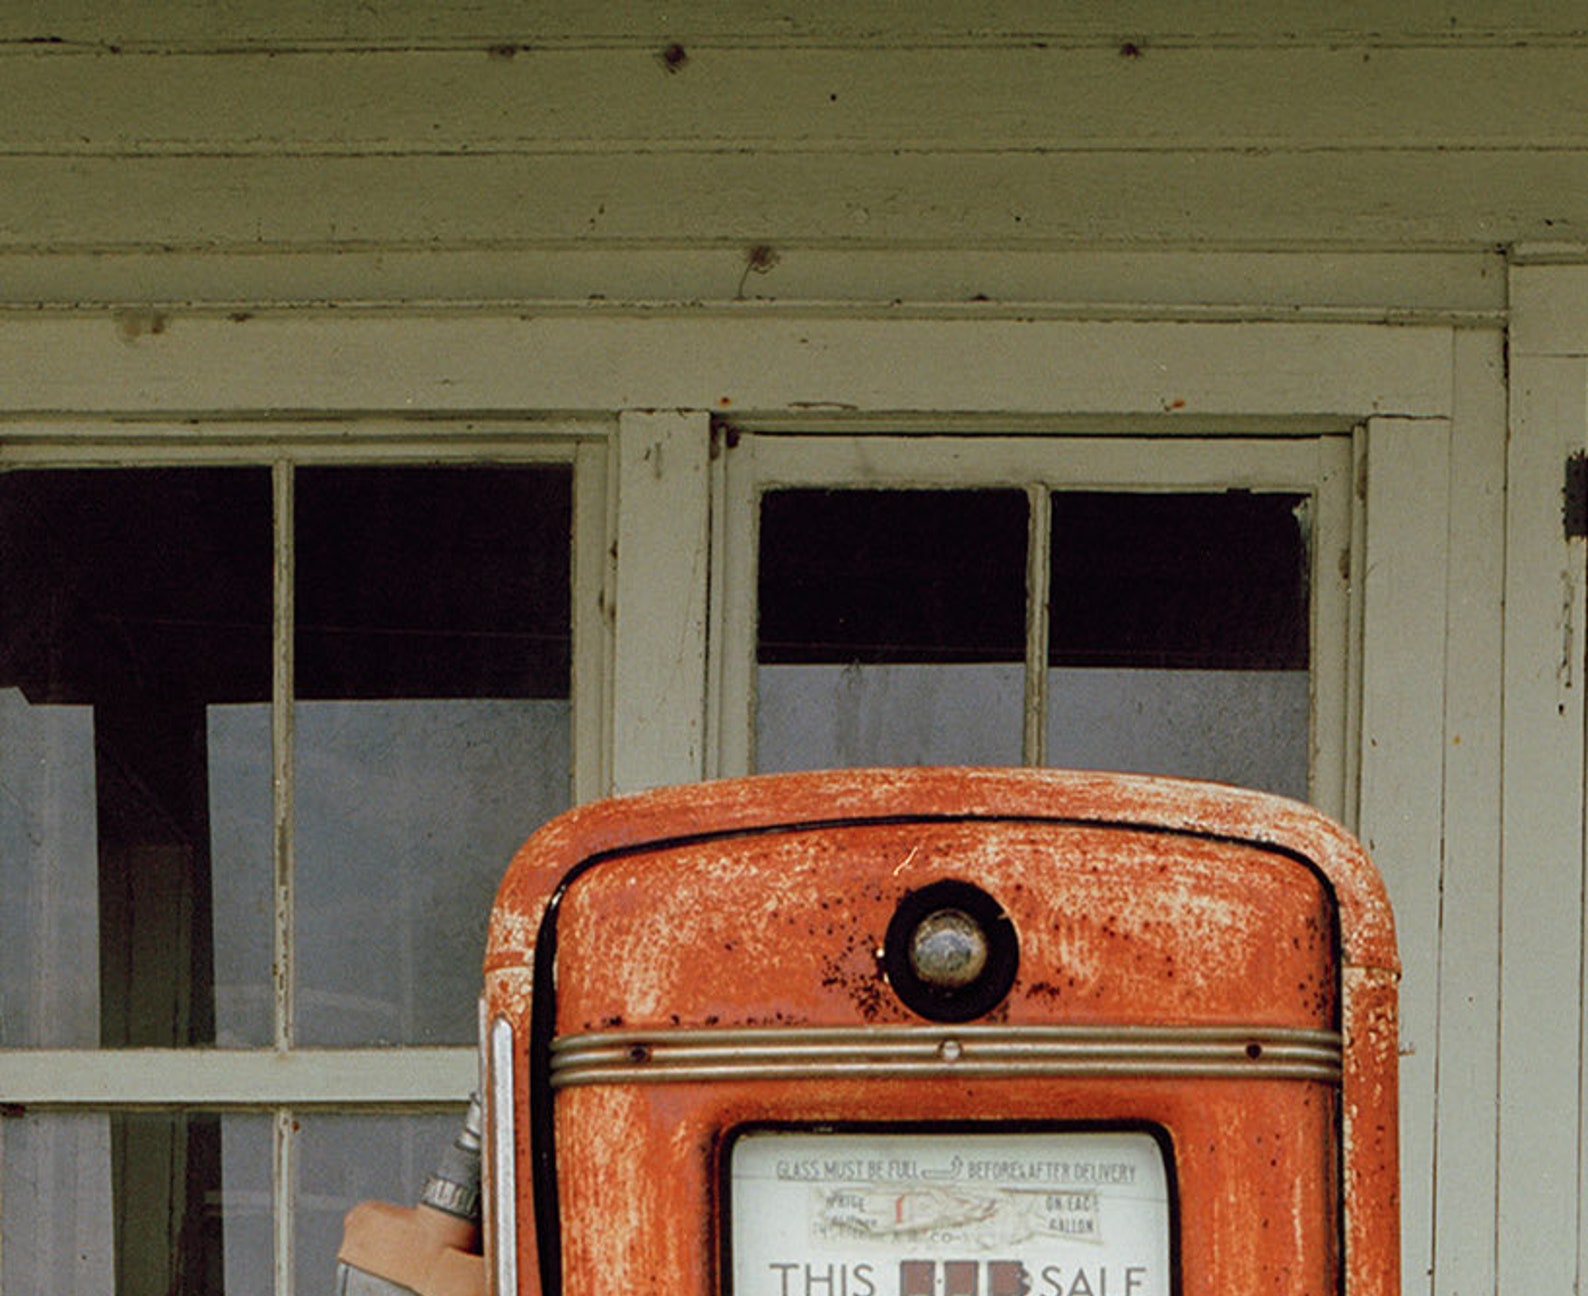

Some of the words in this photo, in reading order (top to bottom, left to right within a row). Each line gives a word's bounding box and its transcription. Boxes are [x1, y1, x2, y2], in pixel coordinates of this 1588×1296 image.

[776, 1159, 820, 1178] GLASS
[824, 1161, 863, 1179] MUST
[868, 1161, 884, 1179] BE
[888, 1160, 917, 1180] FULL
[1073, 1164, 1136, 1183] DELIVERY
